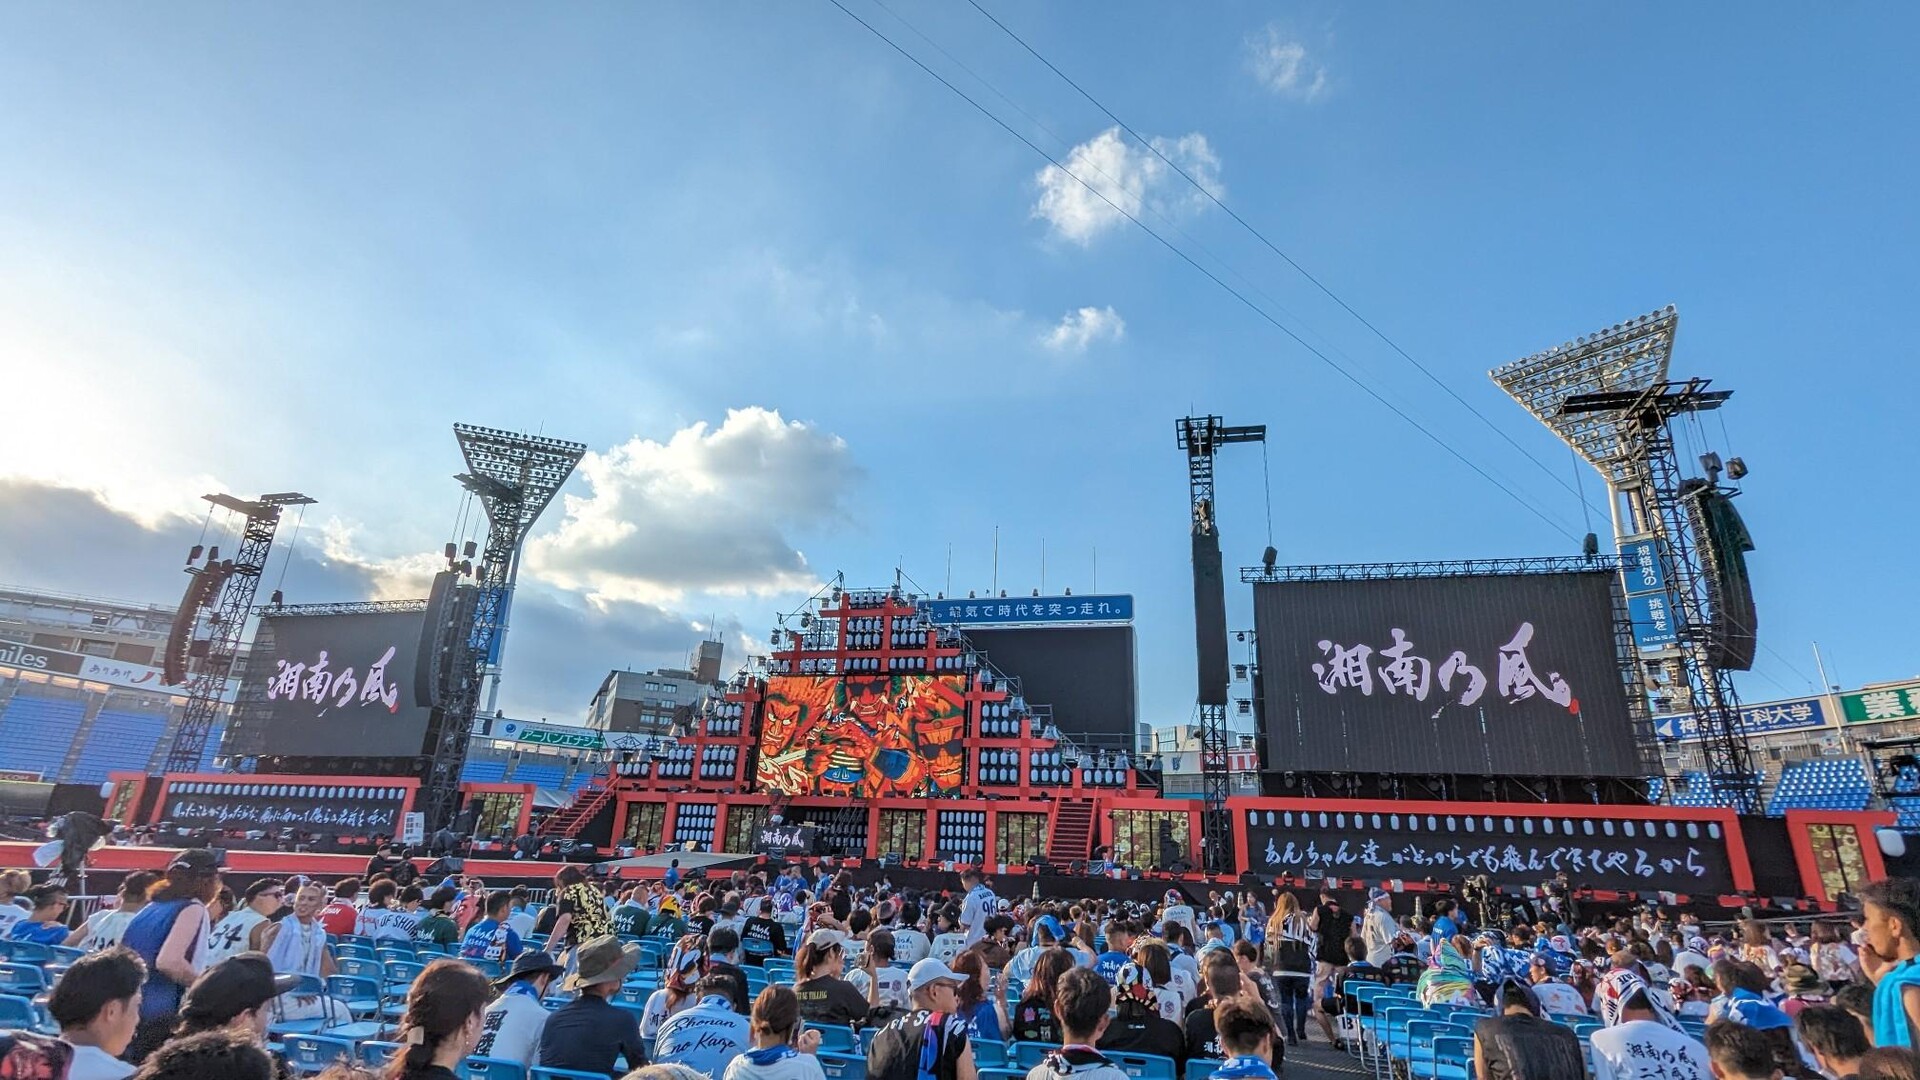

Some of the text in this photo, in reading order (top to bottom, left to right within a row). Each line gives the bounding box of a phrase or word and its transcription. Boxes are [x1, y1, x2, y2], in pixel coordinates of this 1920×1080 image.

[1642, 634, 1677, 642] NISSA
[673, 1016, 737, 1034] Shonan
[671, 1031, 737, 1055] no Kaze
